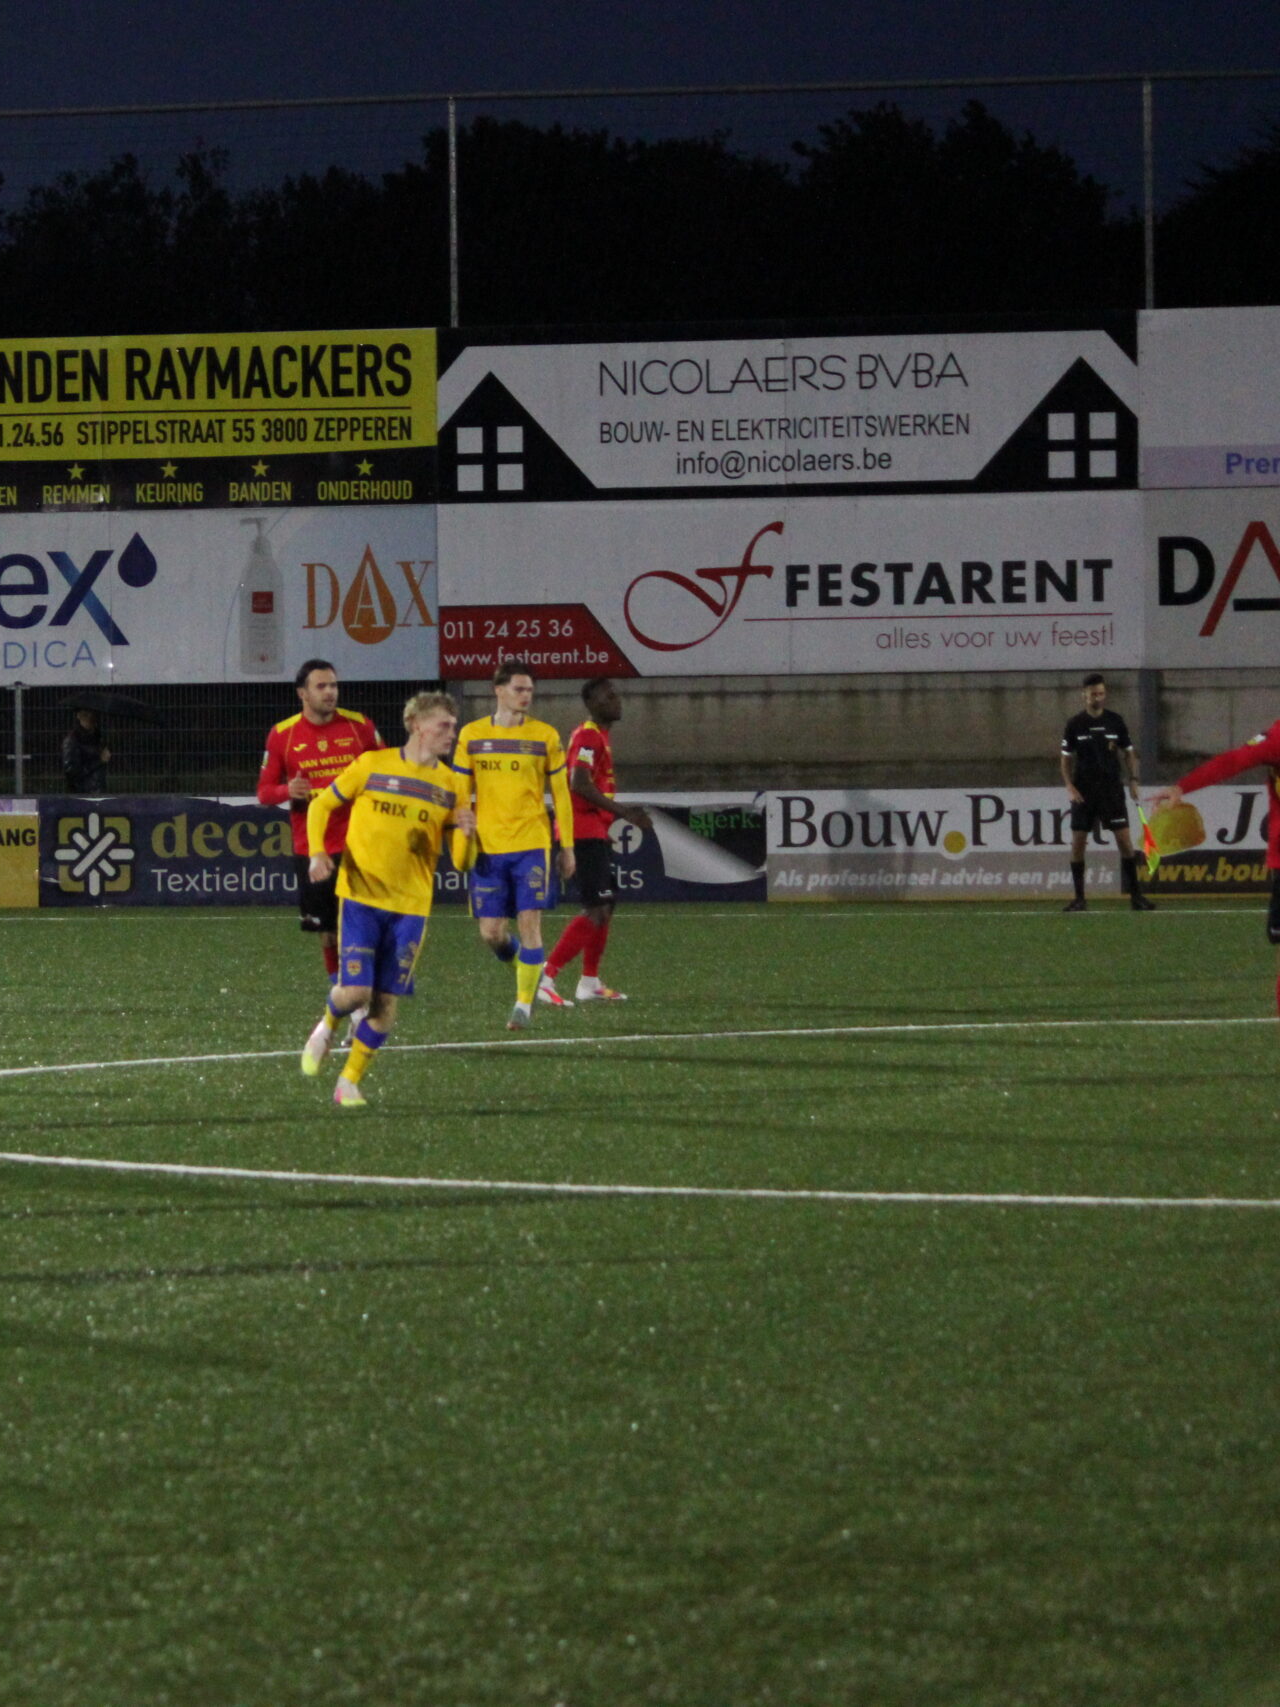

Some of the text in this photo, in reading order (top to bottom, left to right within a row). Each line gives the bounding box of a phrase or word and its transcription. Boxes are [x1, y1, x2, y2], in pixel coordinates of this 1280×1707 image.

[125, 343, 412, 400] RAYMACKERS
[599, 352, 969, 396] NICOLAERS BVBA
[77, 418, 225, 446] STIPPELSTRAAT
[232, 418, 255, 443] 55
[261, 417, 307, 443] 3800
[314, 415, 412, 442] ZEPPEREN
[599, 413, 970, 444] BOUW- EN ELEKTRICITEITSWERKEN
[676, 448, 892, 479] info@nicolaers.be
[1226, 453, 1280, 475] Pre
[43, 484, 111, 505] REMMEN
[136, 482, 204, 503] KEURING
[229, 481, 291, 502] BANDEN
[317, 480, 413, 501] ONDERHOUD
[301, 556, 438, 631] DAX
[785, 559, 1113, 607] FESTARENT
[444, 618, 573, 639] 011 24 25 36
[876, 622, 1114, 649] alles voor uw feest!
[444, 647, 609, 666] www.festarent.be
[774, 867, 1113, 892] Als professioneel advies een put is
